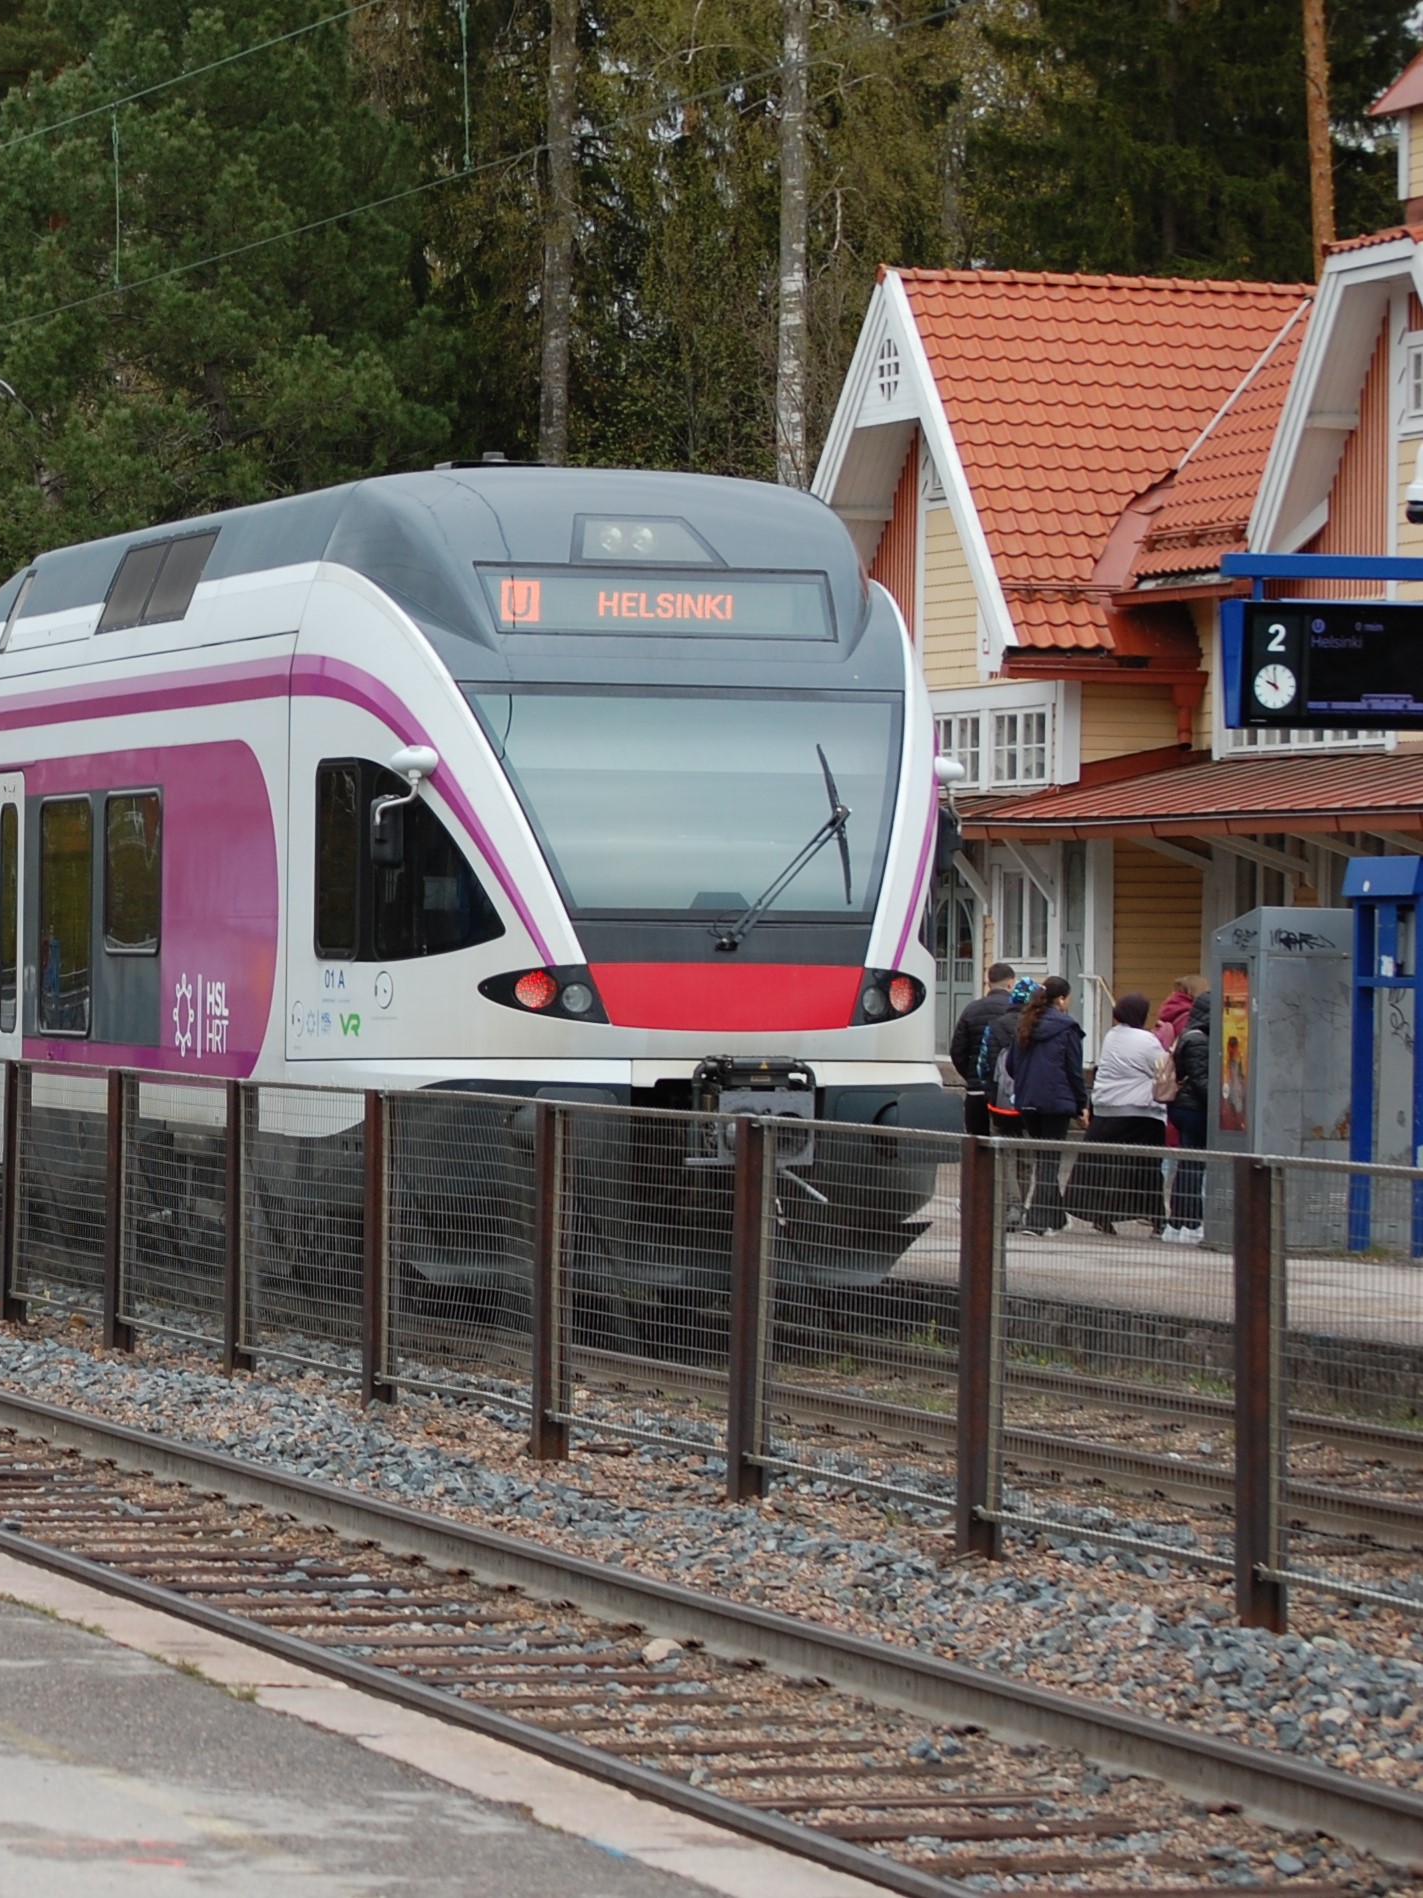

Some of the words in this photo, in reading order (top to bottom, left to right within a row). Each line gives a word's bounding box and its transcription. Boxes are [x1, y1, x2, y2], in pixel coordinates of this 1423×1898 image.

[598, 591, 733, 620] HELSINKI
[1267, 623, 1287, 652] 2
[324, 969, 335, 989] 01
[337, 969, 346, 989] A
[206, 981, 230, 1017] HSL
[206, 1018, 230, 1055] HRT
[339, 1013, 361, 1037] VR
